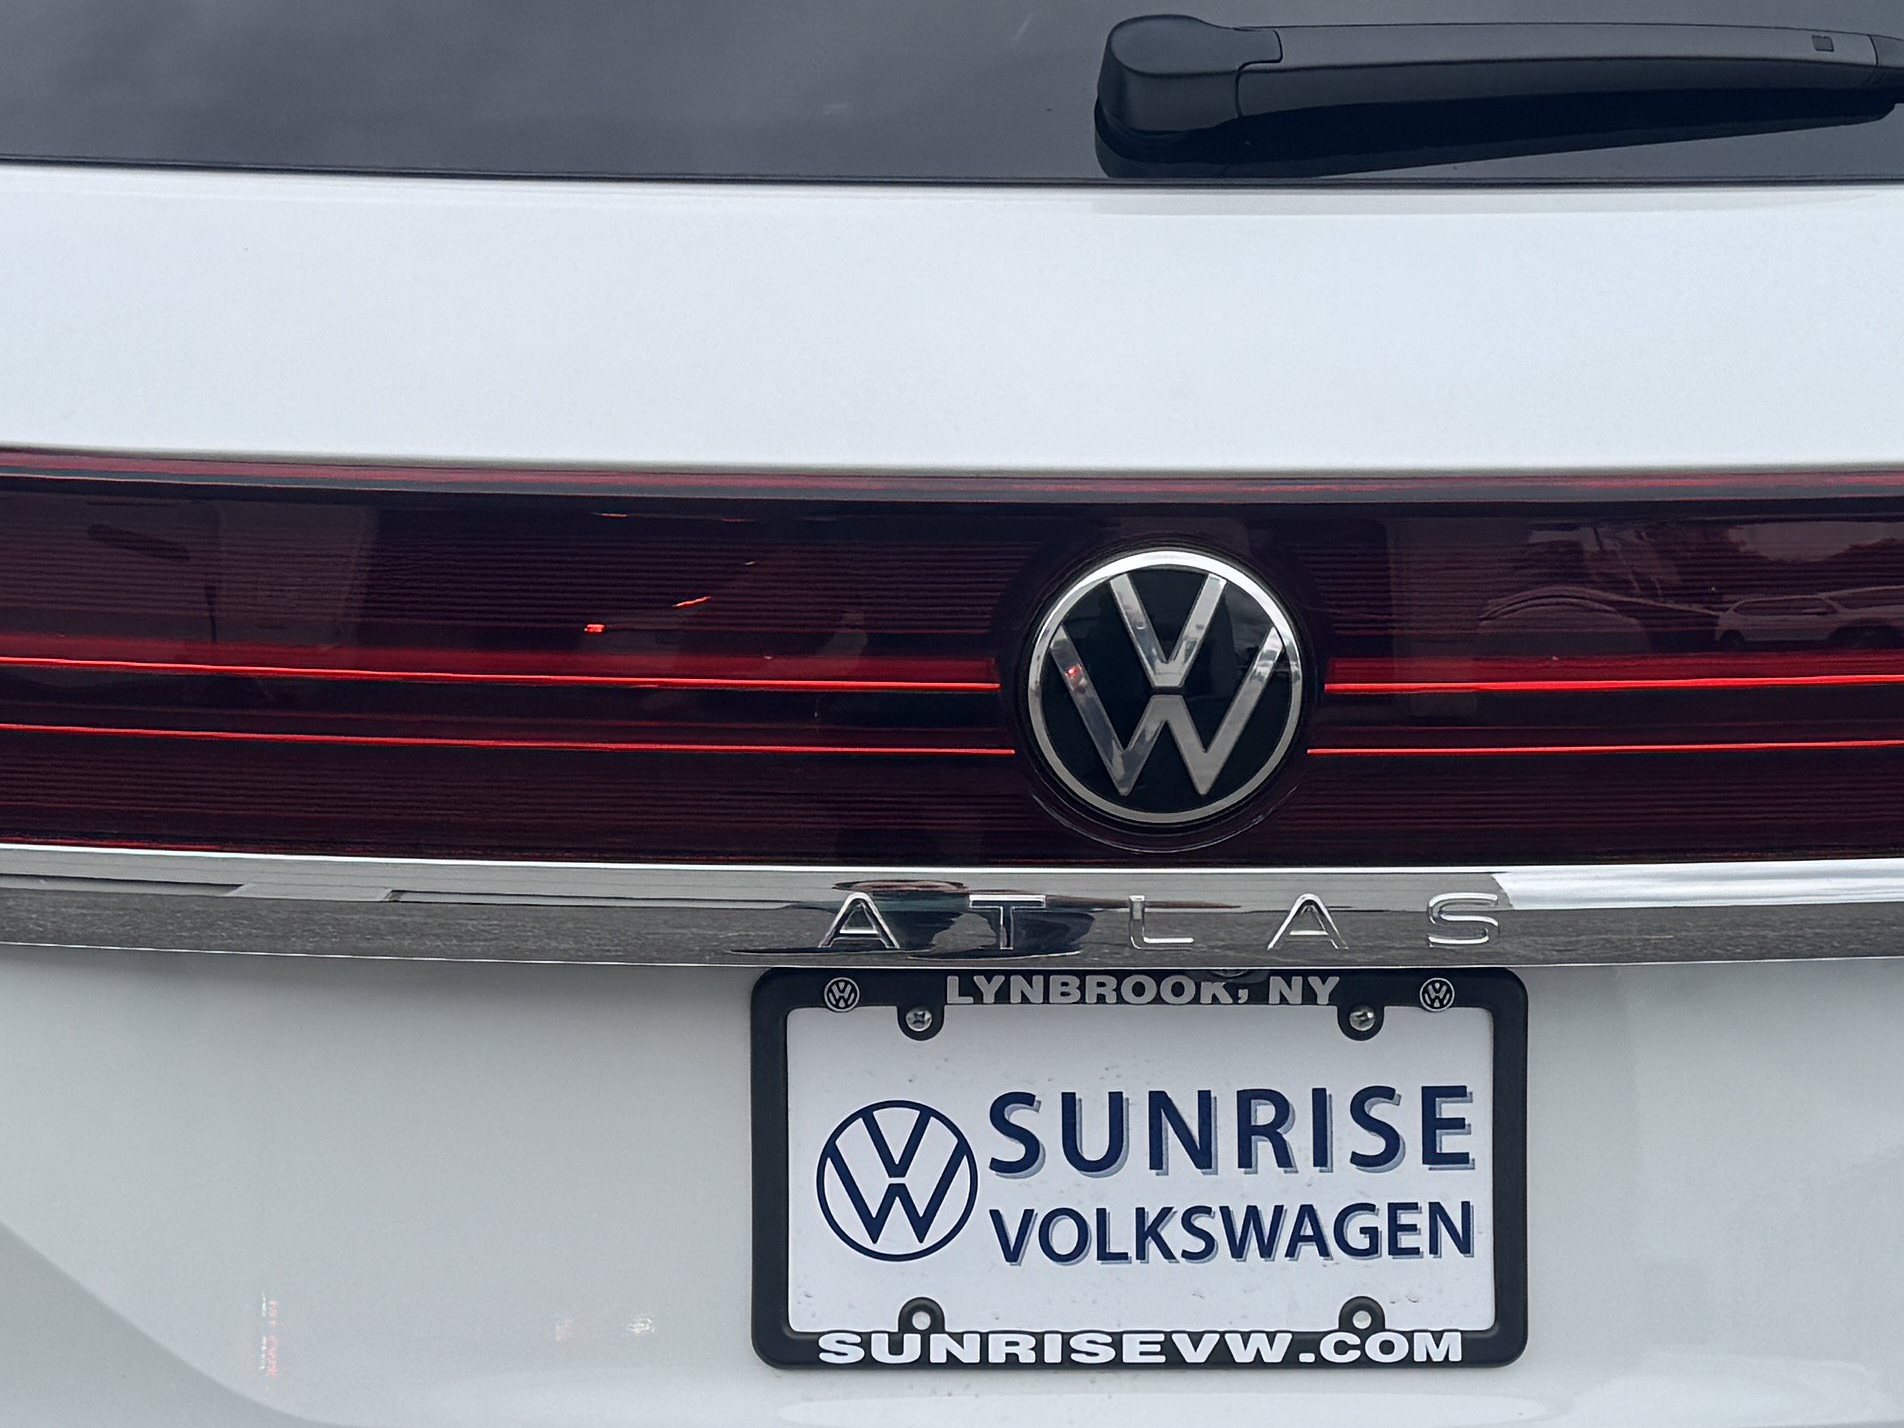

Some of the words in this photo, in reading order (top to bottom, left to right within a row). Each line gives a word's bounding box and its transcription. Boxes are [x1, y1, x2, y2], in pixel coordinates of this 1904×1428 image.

[1028, 548, 1302, 823] VW
[817, 891, 1498, 951] ATLAS
[946, 976, 1252, 1006] LYNBROOK,
[1268, 976, 1341, 1005] NY
[988, 1085, 1476, 1177] SUNRISE
[817, 1100, 978, 1262] VW
[988, 1202, 1475, 1265] VOLKSWAGEN
[818, 1332, 1463, 1364] SUNRISEVW.COM
